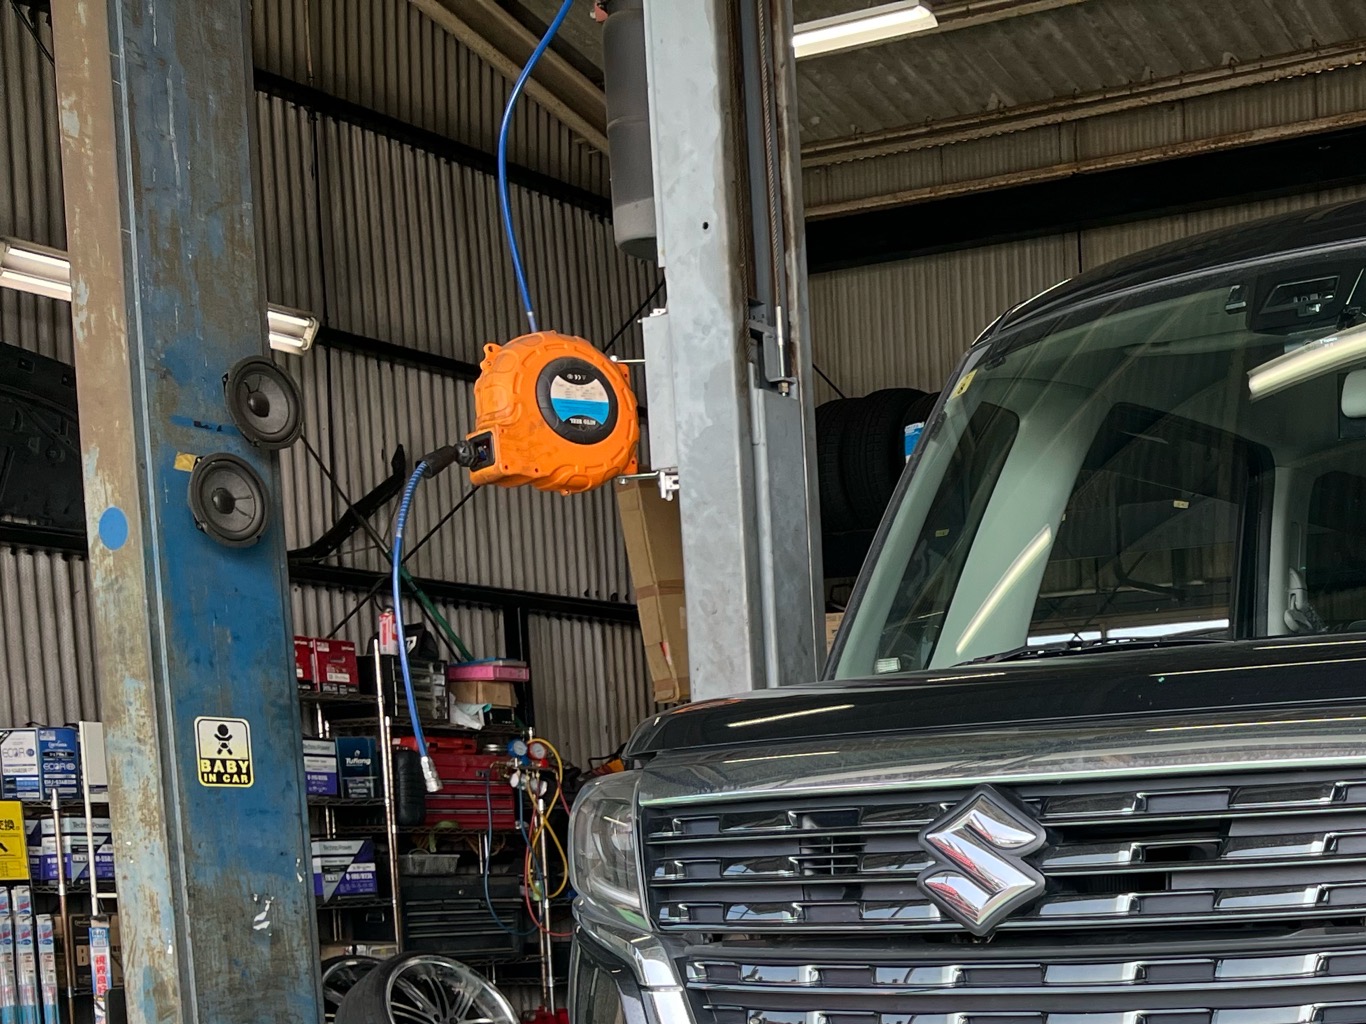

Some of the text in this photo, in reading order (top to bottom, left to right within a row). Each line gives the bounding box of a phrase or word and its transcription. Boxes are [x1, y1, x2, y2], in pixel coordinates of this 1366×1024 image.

[201, 759, 249, 773] BABY
[203, 773, 248, 783] IN CAR
